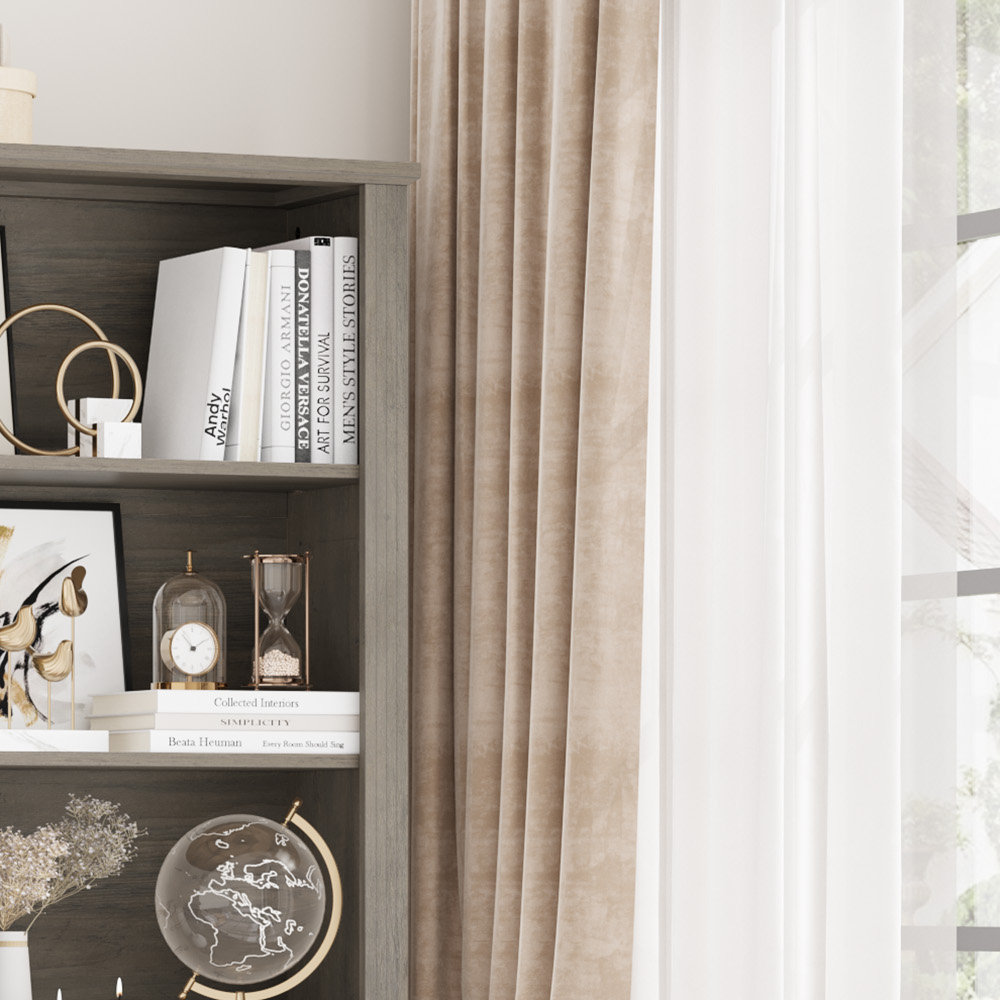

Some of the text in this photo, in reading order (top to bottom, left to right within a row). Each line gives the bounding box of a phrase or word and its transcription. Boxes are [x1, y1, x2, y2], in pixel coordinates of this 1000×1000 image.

[280, 285, 291, 432] GIORGIO ARMANI
[298, 267, 310, 450] DONATELLA VERSACE
[342, 254, 356, 444] MEN'S STYLE STORIES
[204, 392, 222, 438] Andy
[216, 387, 231, 446] Warhol
[317, 332, 331, 455] ART FOR SURVIVAL
[213, 697, 299, 708] Collected Interiors
[168, 736, 243, 748] Beata Heuman
[283, 740, 303, 749] Room
[305, 740, 328, 749] Should
